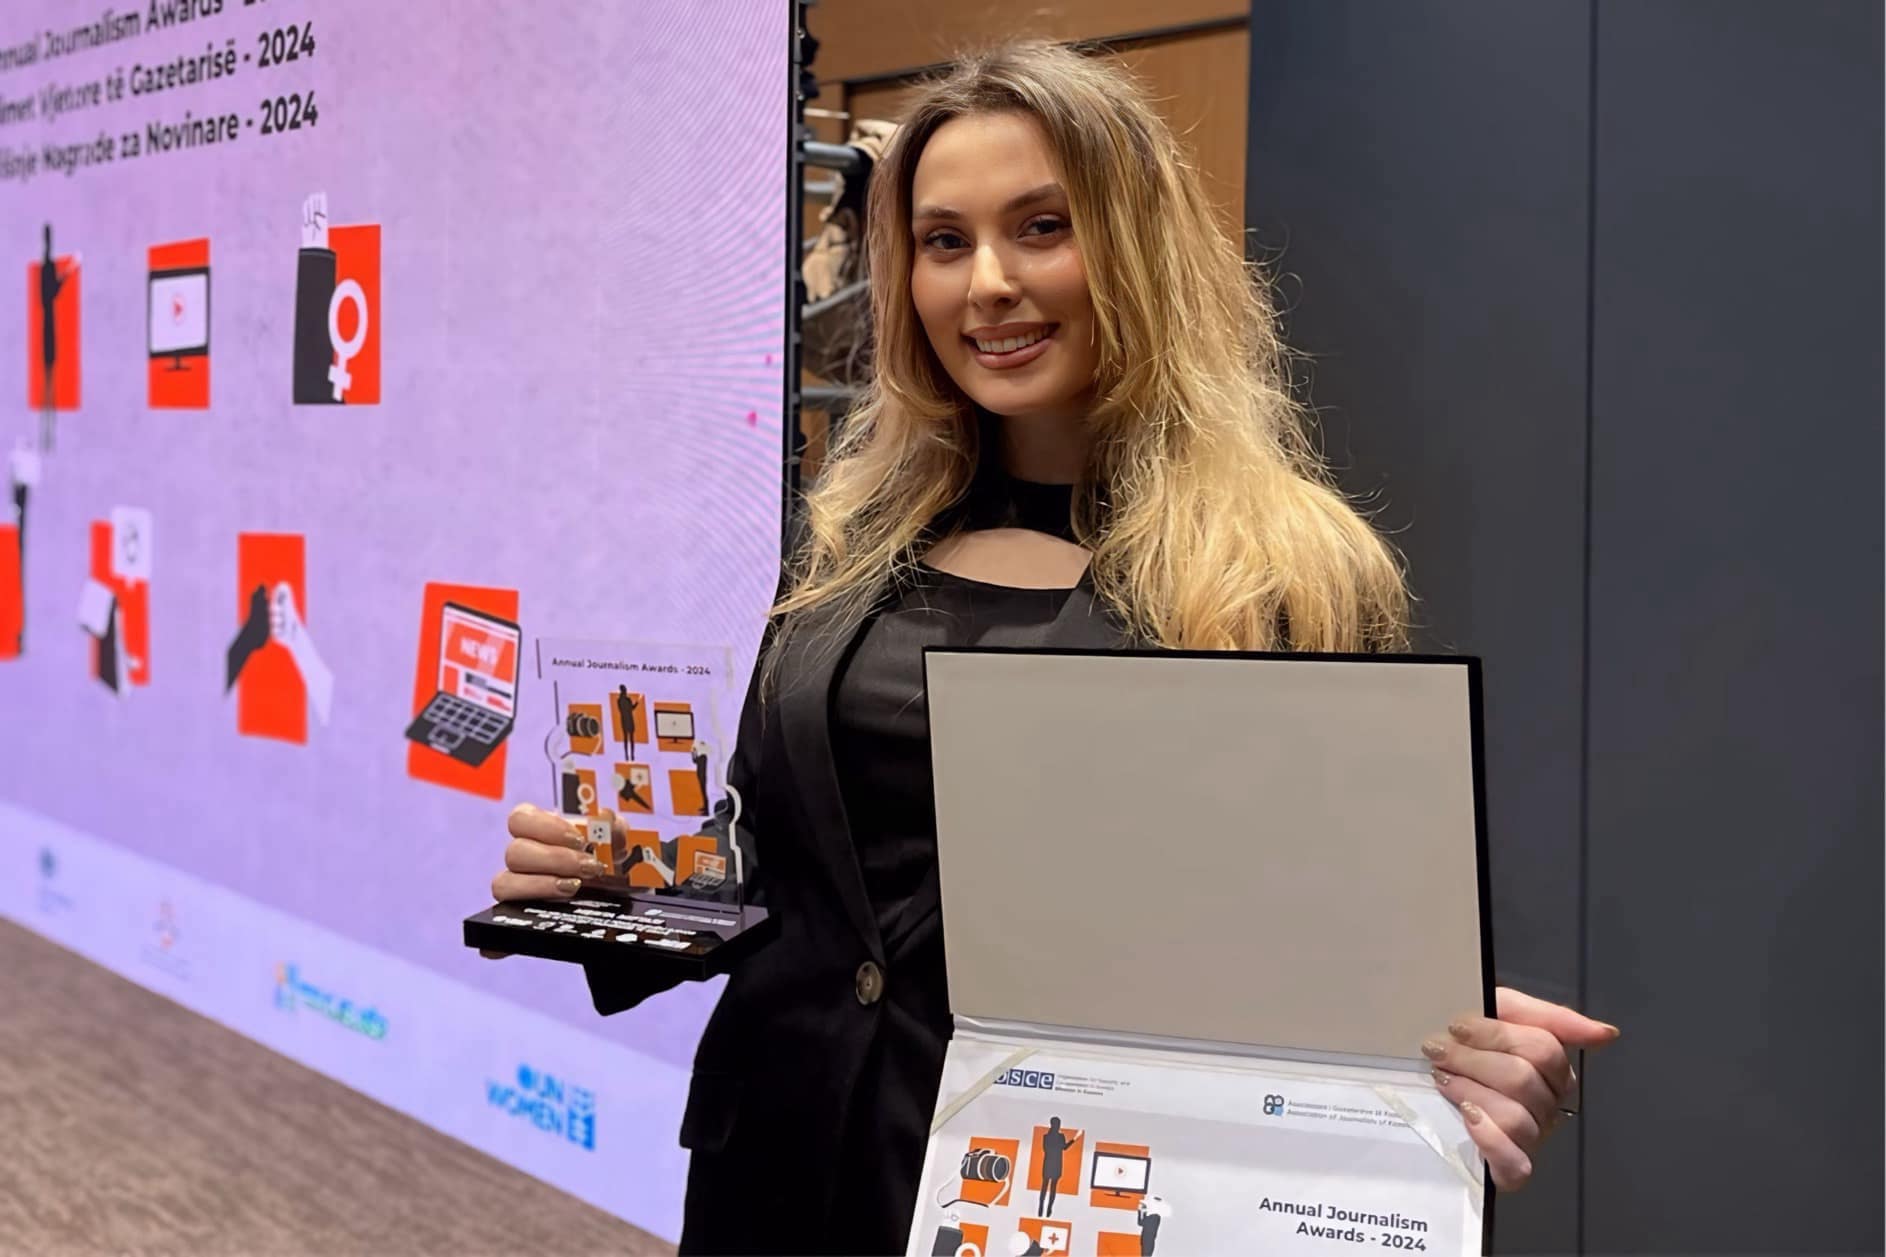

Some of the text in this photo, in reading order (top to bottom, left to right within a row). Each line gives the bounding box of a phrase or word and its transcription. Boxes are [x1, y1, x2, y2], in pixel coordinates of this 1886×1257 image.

[45, 9, 141, 60] Journalism
[145, 0, 223, 33] Awards
[130, 38, 237, 96] Gazetarisë
[258, 20, 315, 68] 2024
[121, 131, 140, 159] za
[147, 110, 238, 154] Novinare
[260, 90, 318, 135] 2024
[460, 636, 498, 666] NEWS
[552, 657, 585, 668] Annual
[587, 659, 639, 671] Journalism
[641, 663, 679, 674] Awards
[687, 665, 711, 675] 2024
[486, 1079, 563, 1136] WOMEN
[1259, 1197, 1428, 1232] Annual Journalism
[1296, 1221, 1365, 1243] Awards
[1381, 1232, 1427, 1251] 2024
